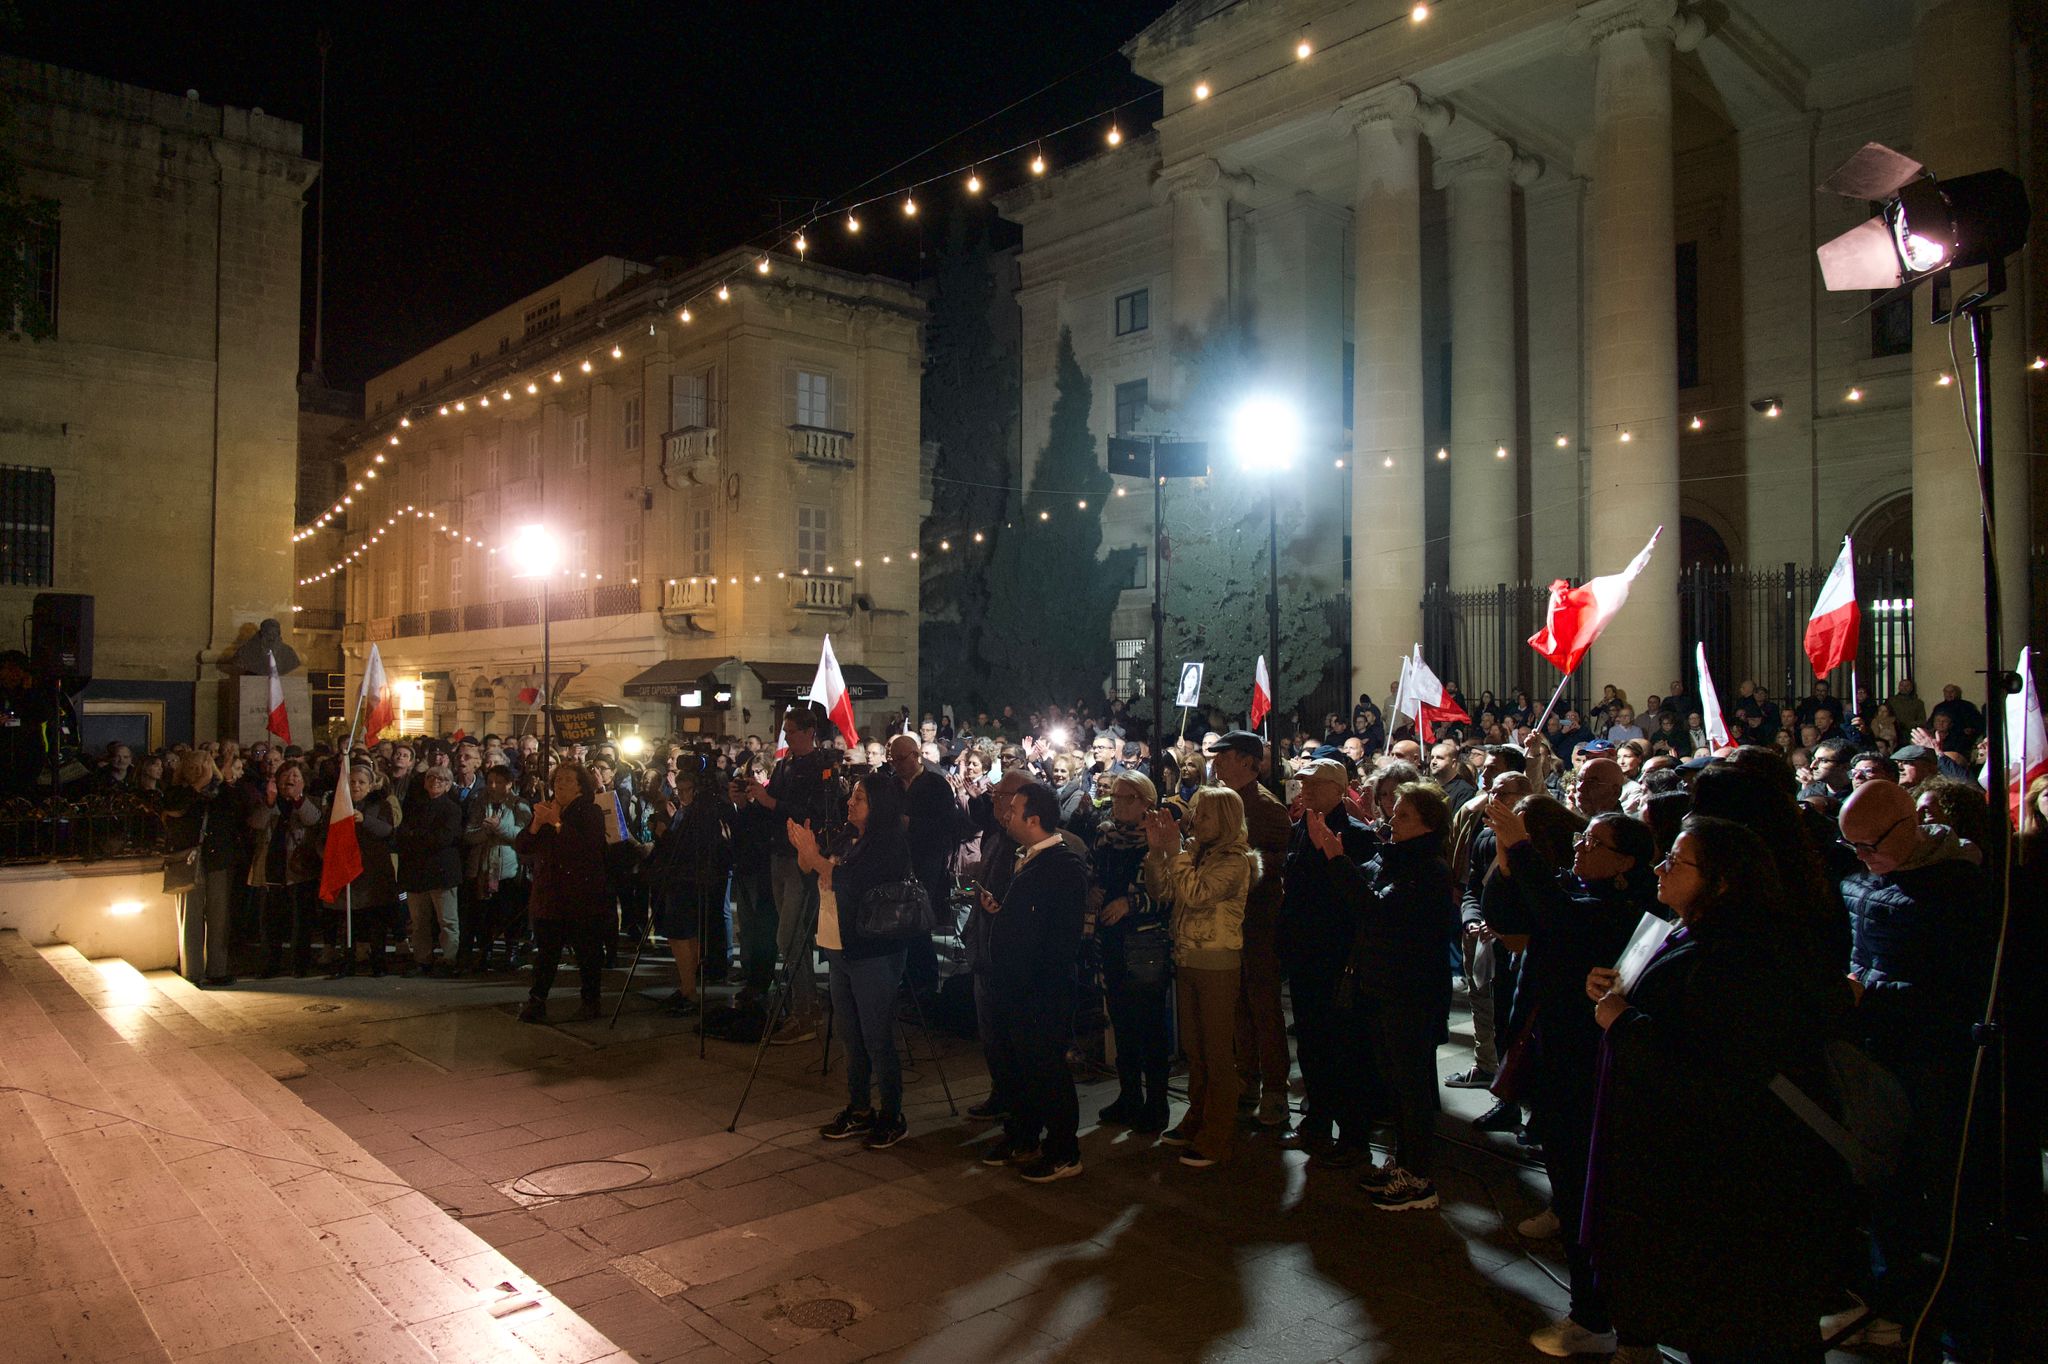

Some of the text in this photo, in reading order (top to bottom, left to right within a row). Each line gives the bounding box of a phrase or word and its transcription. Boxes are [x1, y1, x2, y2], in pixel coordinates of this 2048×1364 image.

[555, 711, 596, 722] DAPHNE
[564, 721, 588, 730] WAS
[561, 727, 596, 739] RIGHT
